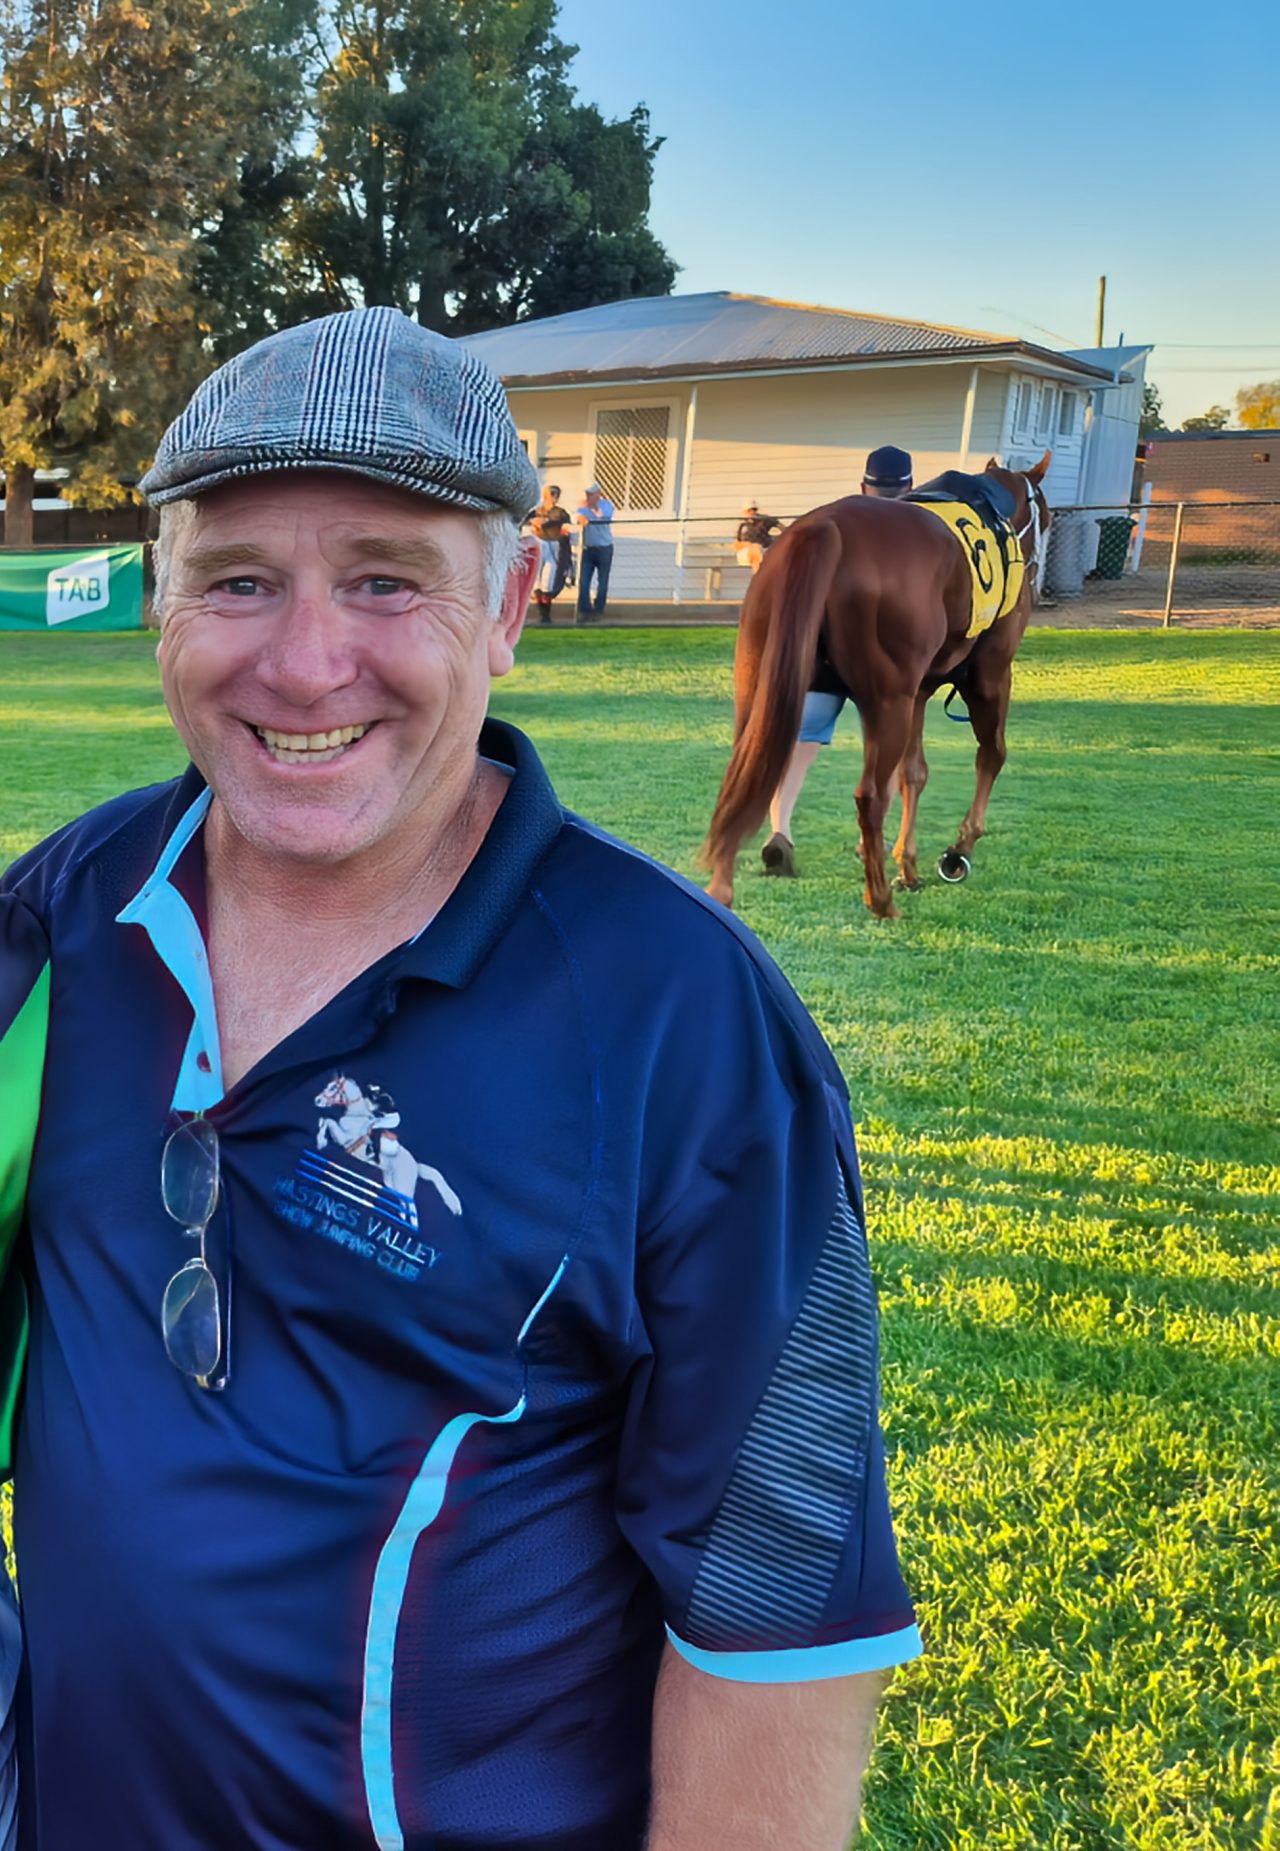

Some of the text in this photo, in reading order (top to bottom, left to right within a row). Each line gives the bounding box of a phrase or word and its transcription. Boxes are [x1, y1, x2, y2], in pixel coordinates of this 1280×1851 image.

[55, 577, 102, 602] TAB
[273, 1176, 442, 1268] HASTINGS VALLEY
[377, 1250, 422, 1281] CLUB
